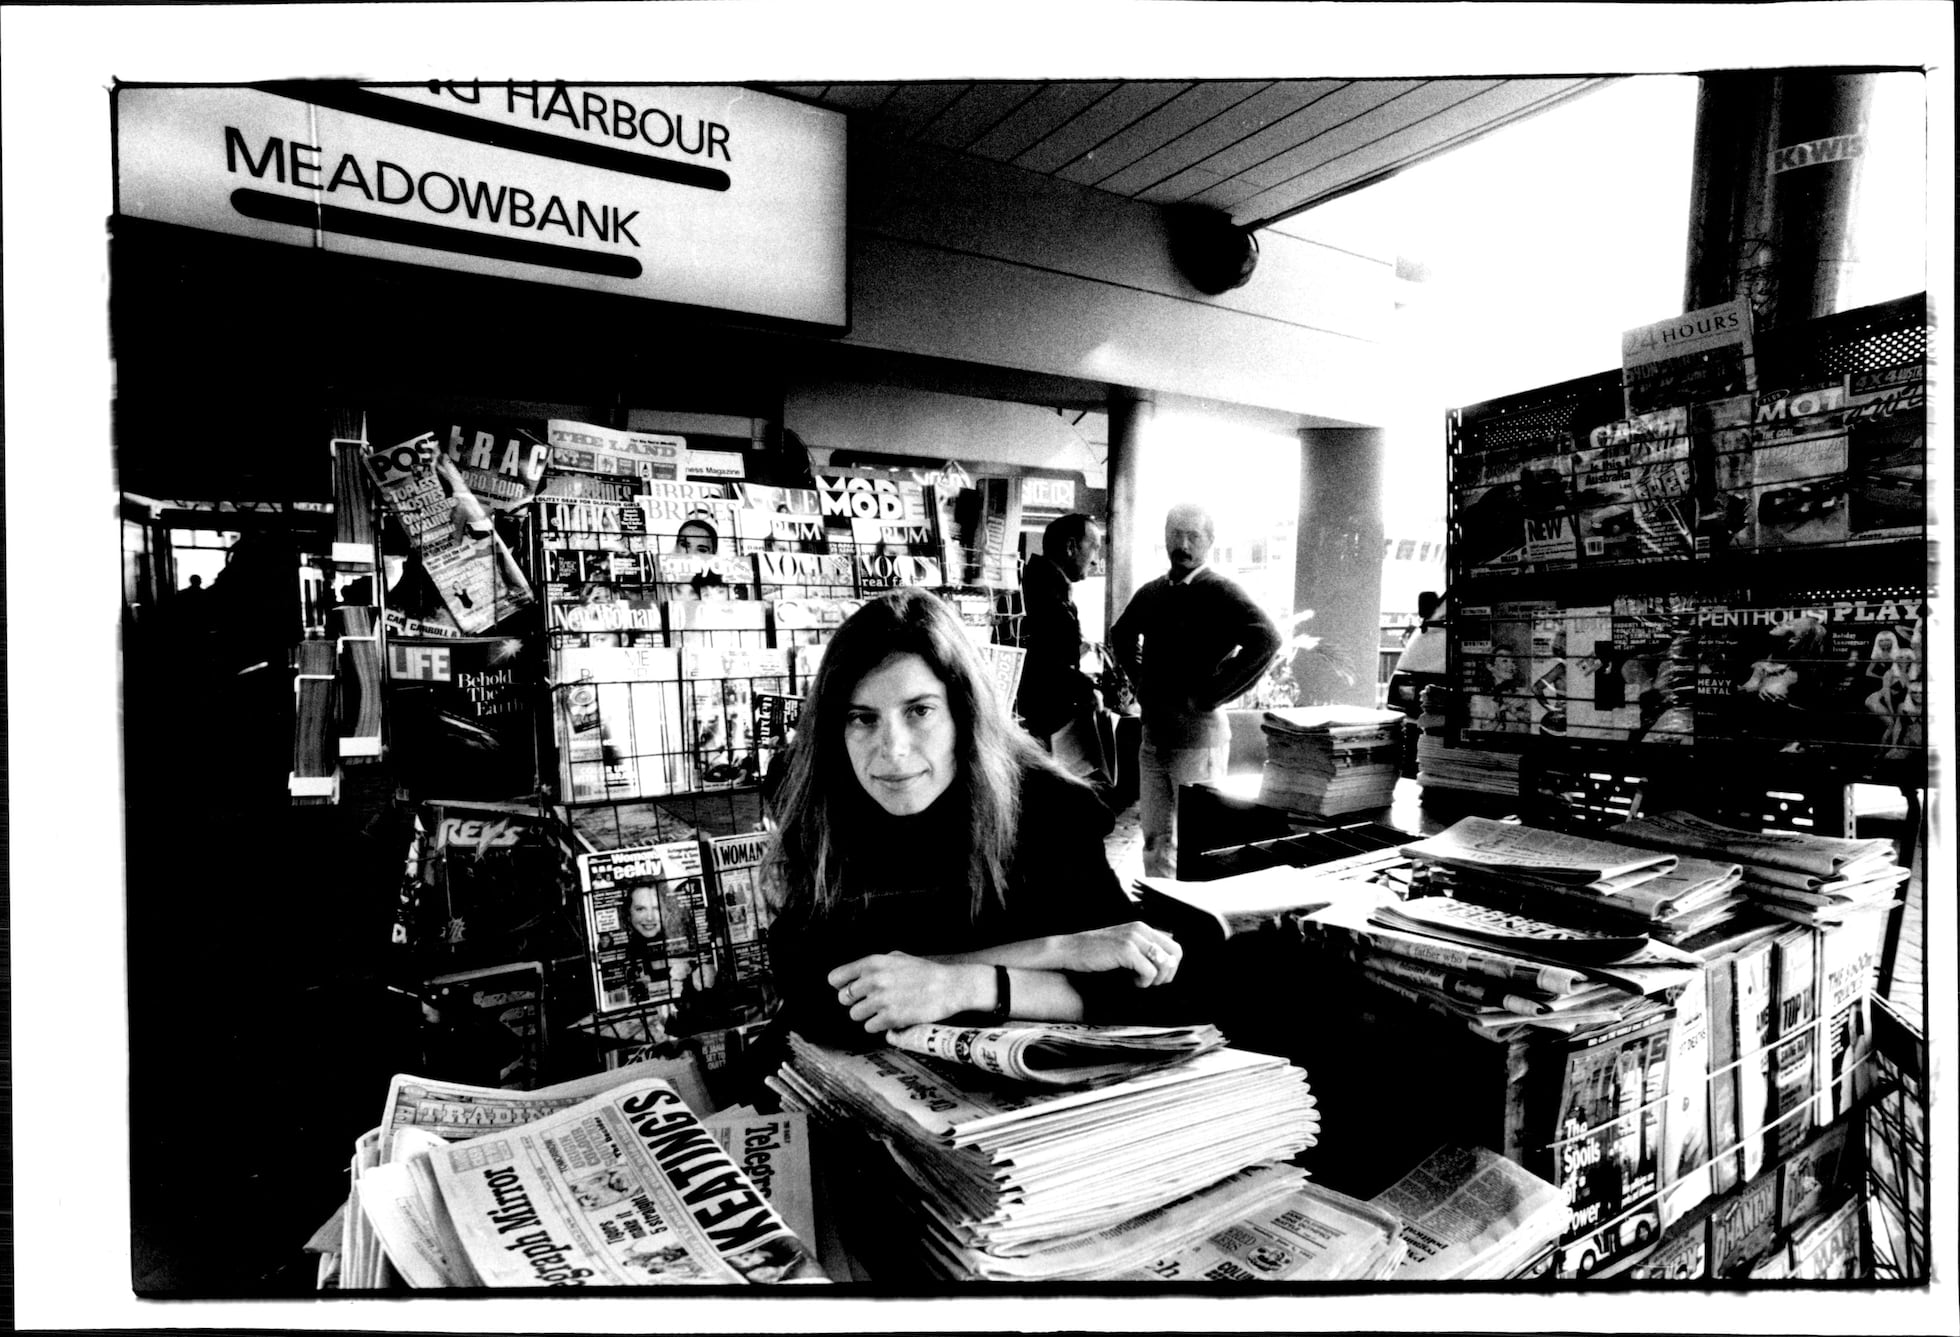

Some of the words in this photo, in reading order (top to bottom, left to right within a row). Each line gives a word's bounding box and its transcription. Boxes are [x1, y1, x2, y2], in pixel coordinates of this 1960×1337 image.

[507, 81, 732, 162] HARBOUR
[224, 127, 641, 247] MEADOWBANK
[1662, 312, 1739, 343] HOURS
[552, 429, 604, 448] THE
[609, 439, 677, 458] LAND
[462, 471, 486, 491] PRO
[491, 477, 525, 499] TOUR
[705, 467, 740, 476] Magazine
[1585, 470, 1631, 486] Australia
[390, 476, 439, 502] TOPLESS
[646, 498, 738, 521] BRIDES
[820, 491, 925, 521] MODE
[861, 577, 889, 588] real
[1832, 598, 1923, 622] PLAY
[409, 622, 449, 637] CARROLL
[387, 643, 451, 682] LIFE
[457, 669, 513, 688] Behold
[1697, 678, 1732, 687] HEAVY
[1697, 687, 1732, 696] METAL
[466, 687, 499, 702] The
[1413, 946, 1441, 960] father
[1443, 950, 1463, 964] who
[1564, 1117, 1589, 1143] The
[558, 1136, 587, 1169] ORIGIN
[570, 1127, 601, 1167] COLOUR
[610, 1143, 622, 1159] The
[1563, 1137, 1601, 1173] Spoils
[622, 1089, 784, 1252] KEATING'S
[483, 1166, 543, 1235] Mirror
[630, 1193, 665, 1230] straight
[650, 1224, 669, 1236] 5
[1566, 1202, 1601, 1233] Power
[598, 1218, 626, 1246] Tigers
